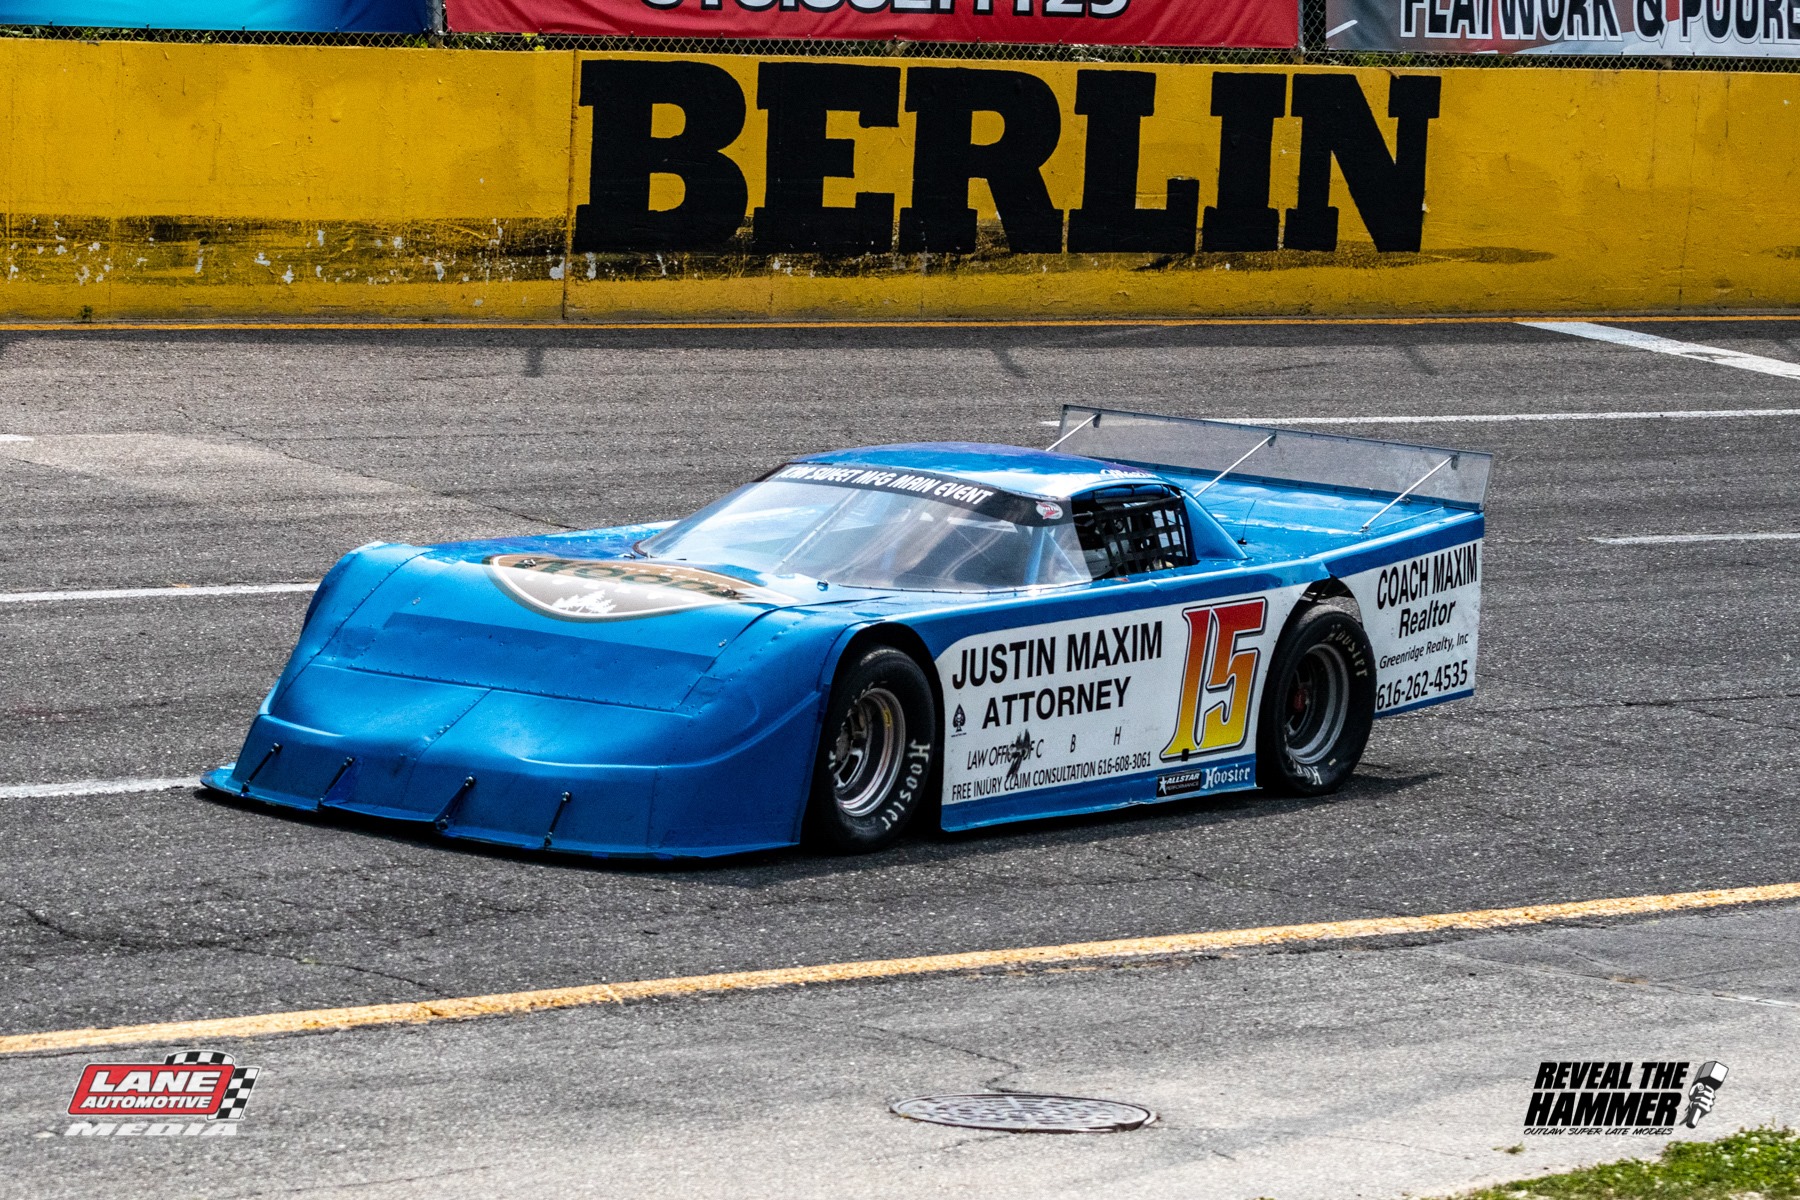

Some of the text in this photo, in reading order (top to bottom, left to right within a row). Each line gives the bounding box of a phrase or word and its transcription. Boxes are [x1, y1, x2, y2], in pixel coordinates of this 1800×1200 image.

[1634, 0, 1667, 46] &
[574, 59, 1441, 255] BERLIN
[805, 466, 863, 482] SWEET
[851, 470, 894, 487] MFG
[888, 474, 940, 493] MAIN
[934, 482, 994, 504] EVENT
[1377, 543, 1477, 610] COACH MAXIM
[1398, 600, 1456, 638] Realtor
[952, 620, 1163, 690] JUSTIN MAXIM
[1379, 632, 1469, 669] Greenridge Realty, Inc
[982, 676, 1131, 730] ATTORNEY
[1160, 597, 1267, 761] 15
[1376, 659, 1469, 710] 616-262-4535
[967, 748, 989, 771] LAW
[1036, 738, 1044, 758] C
[1070, 733, 1077, 753] B
[1113, 726, 1122, 746] H
[952, 750, 1151, 801] FREE INJURY CLAIM CONSULTATION 616-608-3061
[1166, 773, 1200, 785] ALLSTAR
[1201, 763, 1251, 790] Hoosier
